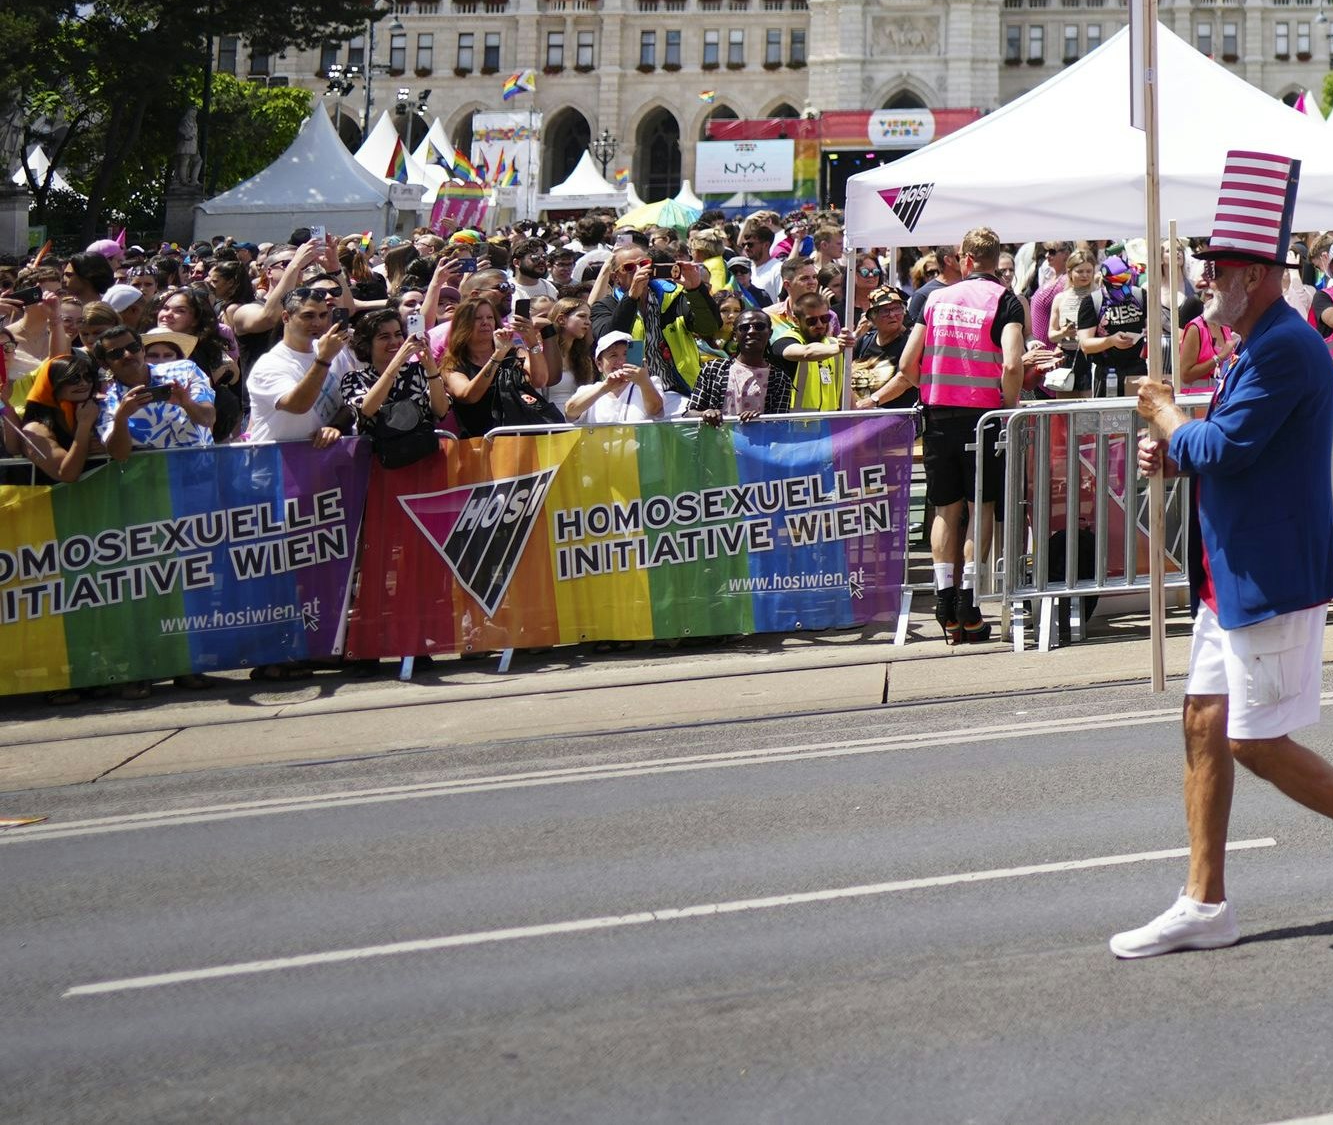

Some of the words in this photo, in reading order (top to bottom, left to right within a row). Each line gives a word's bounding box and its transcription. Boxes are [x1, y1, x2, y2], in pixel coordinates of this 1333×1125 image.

[882, 129, 919, 137] PRIDE
[724, 162, 766, 174] NYX
[896, 186, 934, 203] HOSI
[456, 483, 545, 532] HOSI
[554, 464, 888, 543] HOMOSEXUELLE
[230, 524, 349, 581] WIEN
[557, 518, 774, 581] INITIATIVE
[786, 500, 891, 547] WIEN
[729, 567, 865, 593] www.hosiwien.at
[160, 596, 321, 633] www.hosiwien.at
